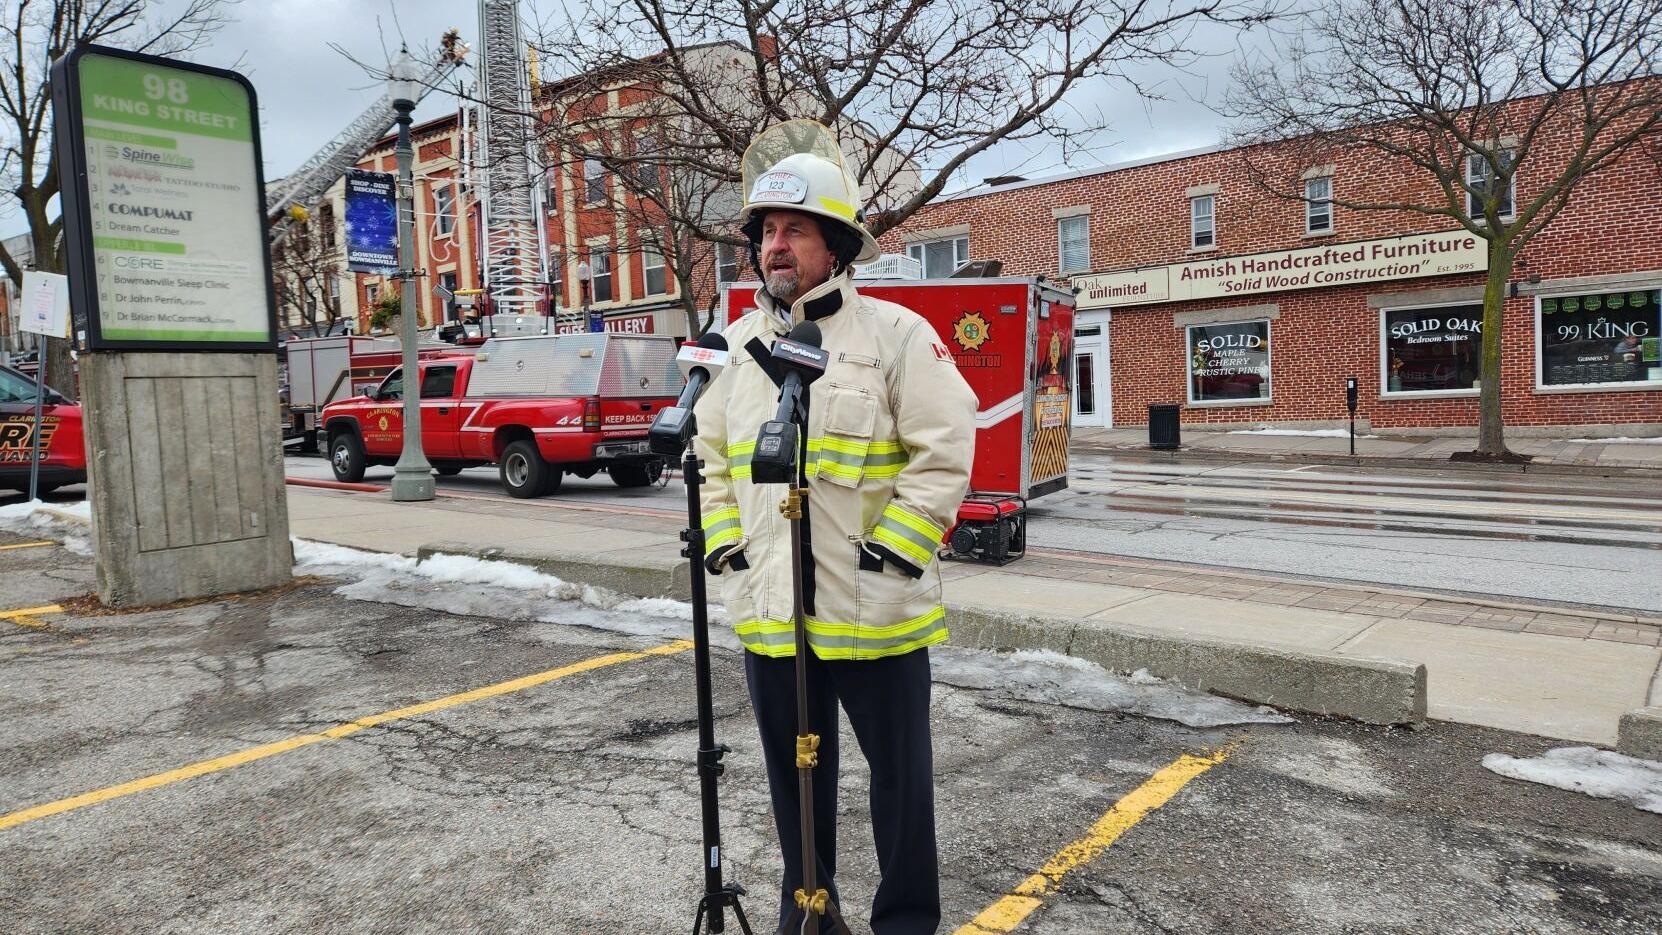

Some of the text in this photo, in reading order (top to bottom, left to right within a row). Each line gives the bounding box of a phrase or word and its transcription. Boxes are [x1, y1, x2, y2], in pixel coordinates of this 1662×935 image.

[143, 73, 189, 104] 98
[93, 94, 238, 129] KING STREET
[353, 186, 387, 195] DISCOVER
[769, 181, 785, 190] 123
[108, 202, 193, 222] COMPUMAT
[109, 221, 180, 236] Dream Catcher
[349, 256, 398, 266] BOWMANVILLE
[352, 251, 394, 260] DOWNTOWN
[1180, 237, 1476, 281] Amish Handcrafted Furniture
[114, 256, 164, 270] CORE
[114, 275, 230, 290] Bowmanville Sleep Clinic
[1266, 272, 1310, 289] Wood
[1455, 262, 1475, 271] 1995
[1076, 278, 1101, 291] Oak
[1089, 282, 1147, 299] unlimited
[115, 293, 127, 302] Dr
[129, 294, 152, 304] John
[117, 312, 129, 321] Dr
[131, 312, 155, 322] Brian
[603, 317, 647, 334] ALLERY
[1391, 317, 1483, 339] SOLID OAK
[1558, 321, 1649, 341] 99 KING
[1197, 334, 1261, 353] SOLID
[1407, 333, 1469, 344] Bedroom Suites
[780, 343, 822, 362] CityNews
[1213, 348, 1247, 358] MAPLE
[952, 355, 1001, 367] RINGTON
[1208, 358, 1250, 367] CHERRY
[1199, 367, 1236, 377] RUSTIC
[605, 415, 625, 424] KEEP
[625, 414, 645, 423] BACK
